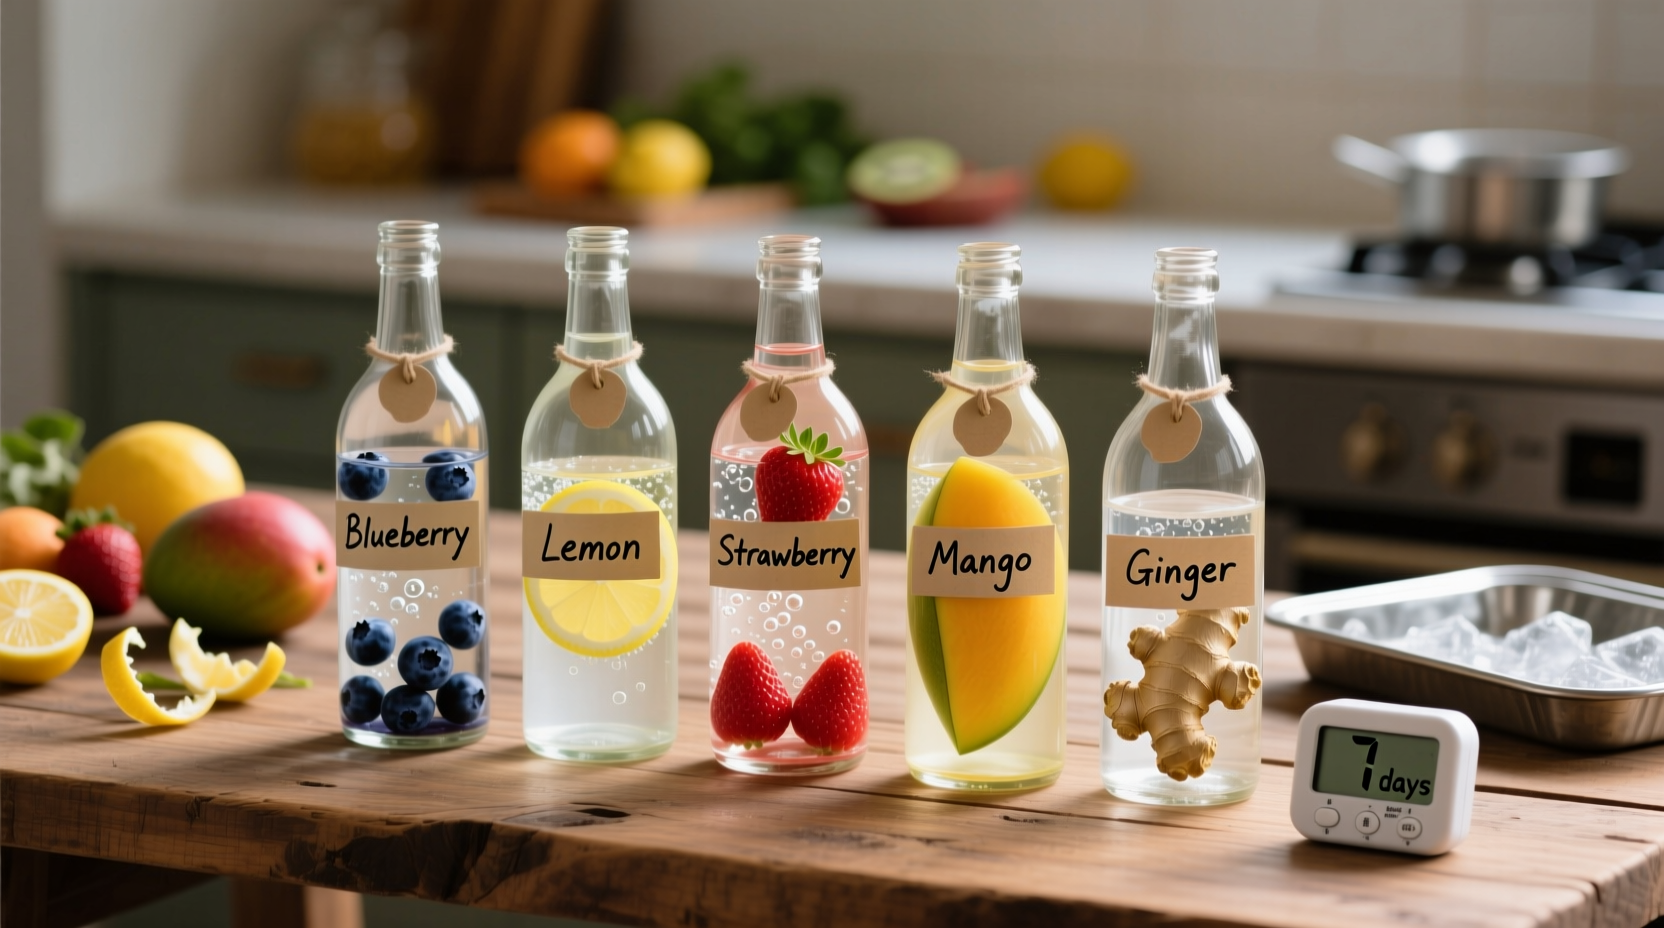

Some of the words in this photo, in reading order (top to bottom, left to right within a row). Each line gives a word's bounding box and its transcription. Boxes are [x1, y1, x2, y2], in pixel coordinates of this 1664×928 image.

[346, 512, 470, 561] Blueberry
[541, 522, 641, 563] Lemon
[718, 533, 857, 579] Strawberry
[928, 540, 1032, 592] Mango
[1125, 547, 1237, 602] Ginger
[1351, 735, 1379, 791] 7
[1379, 767, 1431, 800] days
